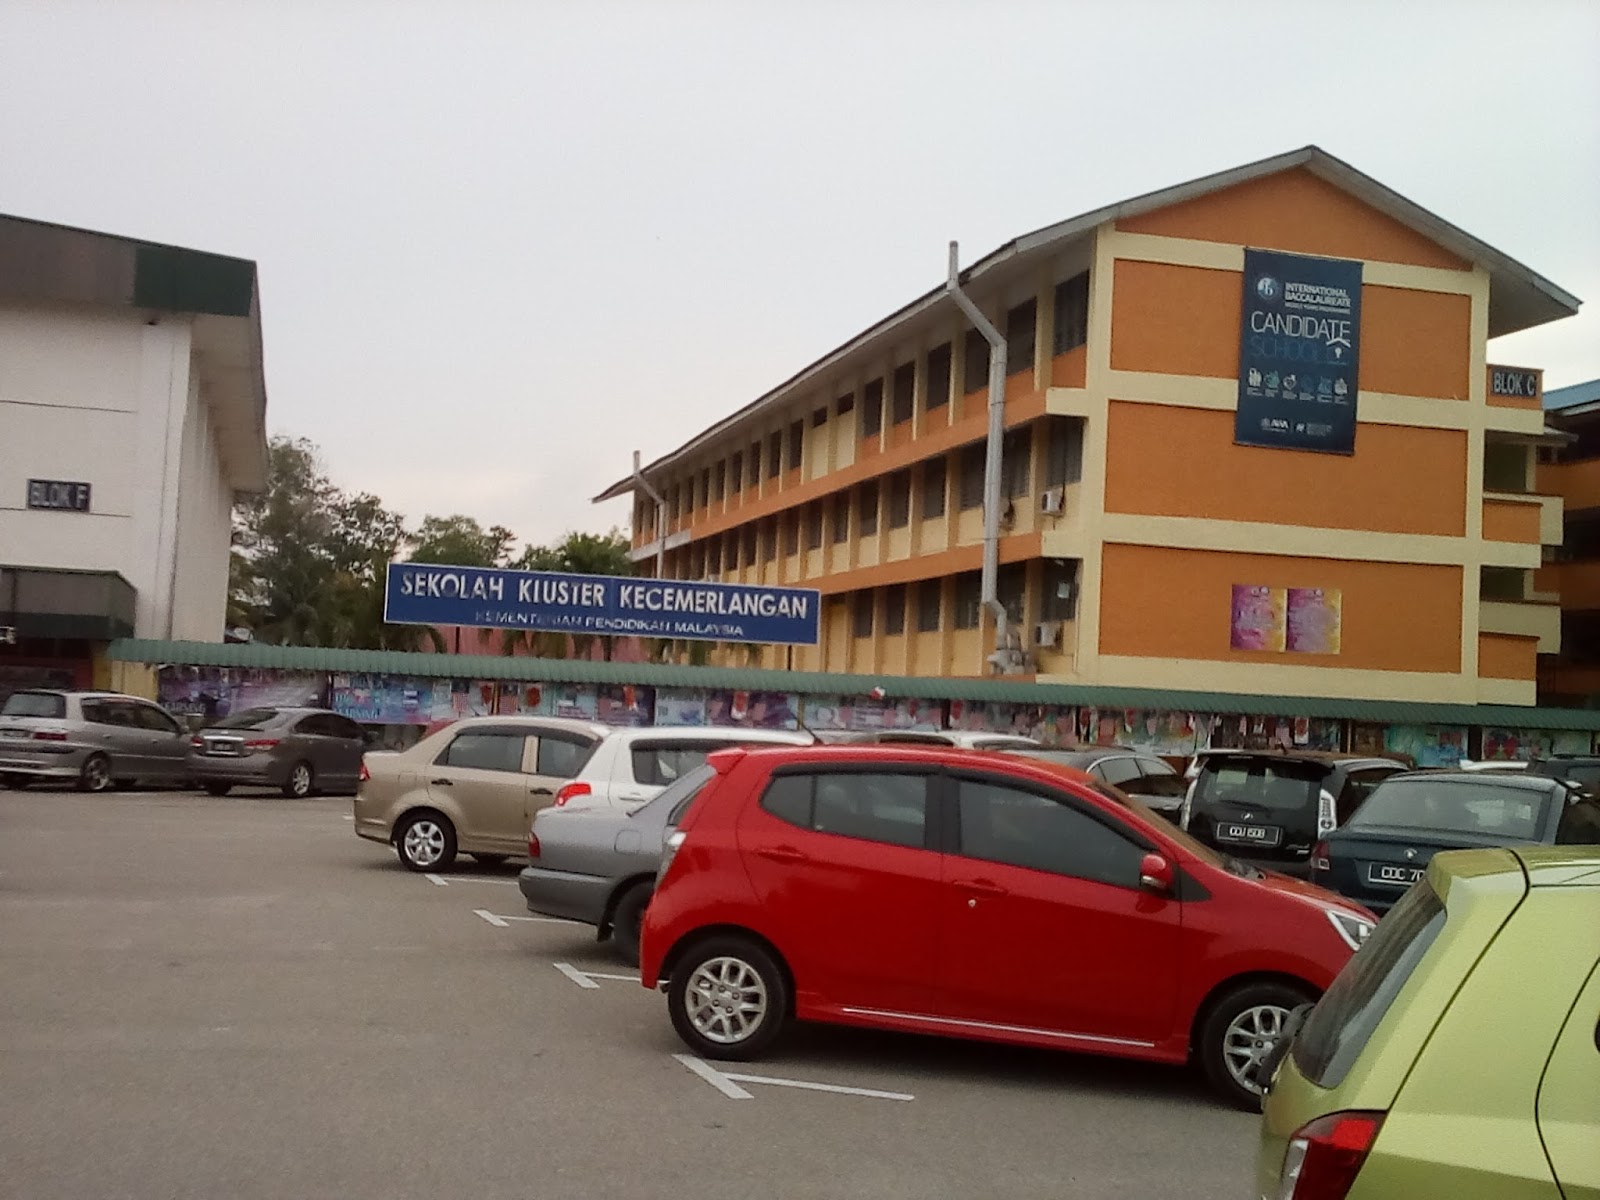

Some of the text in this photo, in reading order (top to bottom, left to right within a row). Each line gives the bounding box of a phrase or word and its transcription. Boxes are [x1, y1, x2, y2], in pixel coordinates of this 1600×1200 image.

[1251, 311, 1351, 341] CANDIDATE
[1494, 372, 1535, 396] BLOK C
[401, 571, 504, 601] SEKOLAH
[619, 584, 808, 620] KECEMERLANGAN
[674, 622, 745, 637] MALAYSIA
